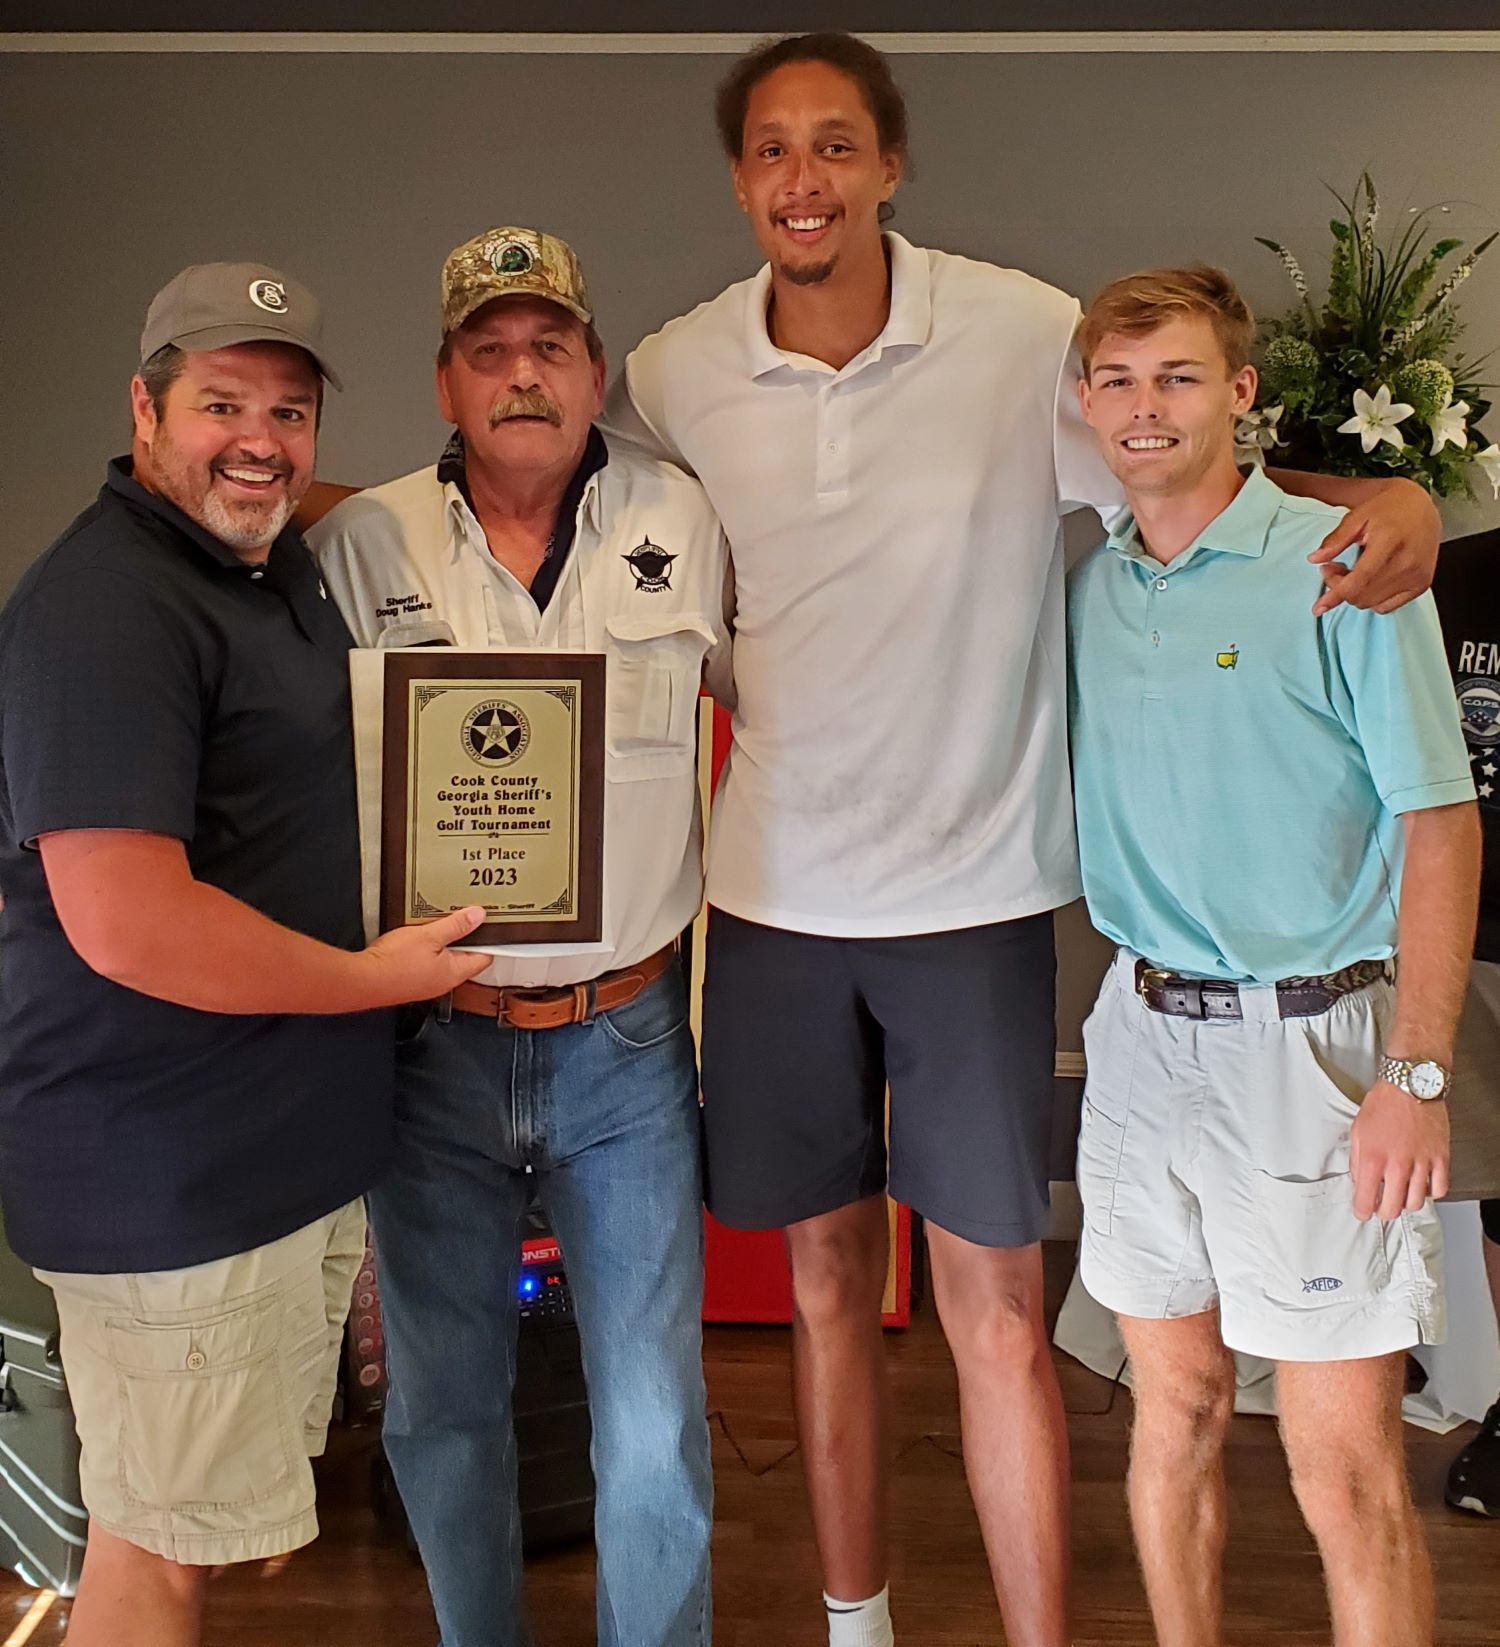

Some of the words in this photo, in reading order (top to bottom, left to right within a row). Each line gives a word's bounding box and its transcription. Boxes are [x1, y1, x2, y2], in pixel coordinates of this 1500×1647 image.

[640, 585, 667, 593] COUNTY
[386, 593, 419, 607] Sheriff
[375, 607, 399, 618] Doug
[403, 601, 432, 613] Hanks
[451, 775, 486, 787] Cook
[491, 775, 538, 788] County
[437, 790, 489, 803] Georgia
[494, 788, 552, 801] Sheriff's
[453, 804, 492, 816] Youth
[498, 804, 536, 815] Home
[436, 819, 465, 831] Golf
[471, 819, 551, 831] Tournament
[462, 848, 482, 861] 1st
[488, 847, 527, 860] Place
[469, 867, 518, 887] 2023
